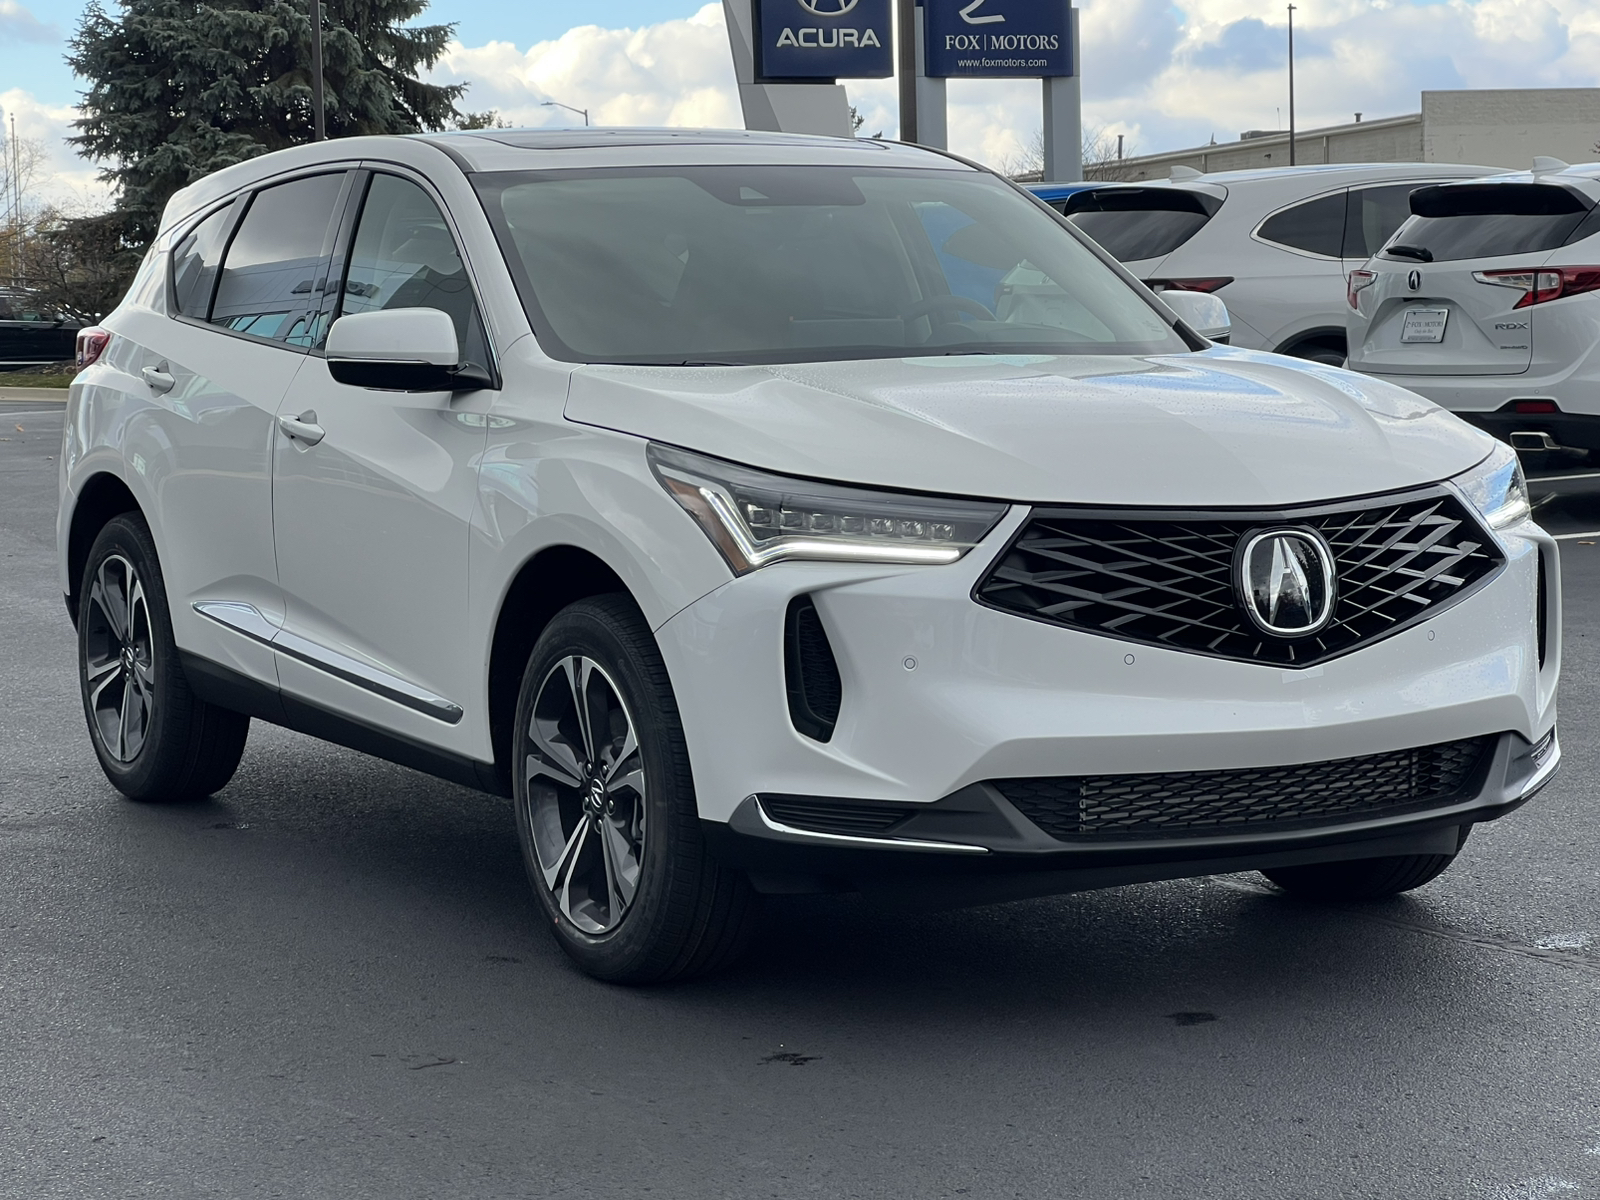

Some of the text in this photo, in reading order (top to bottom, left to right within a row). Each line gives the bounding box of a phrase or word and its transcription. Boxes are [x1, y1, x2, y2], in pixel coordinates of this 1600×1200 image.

[776, 27, 881, 48] ACURA
[945, 34, 1059, 50] FOX MOTORS
[957, 57, 1048, 67] www.foxmotors.com
[1494, 321, 1529, 331] RDX
